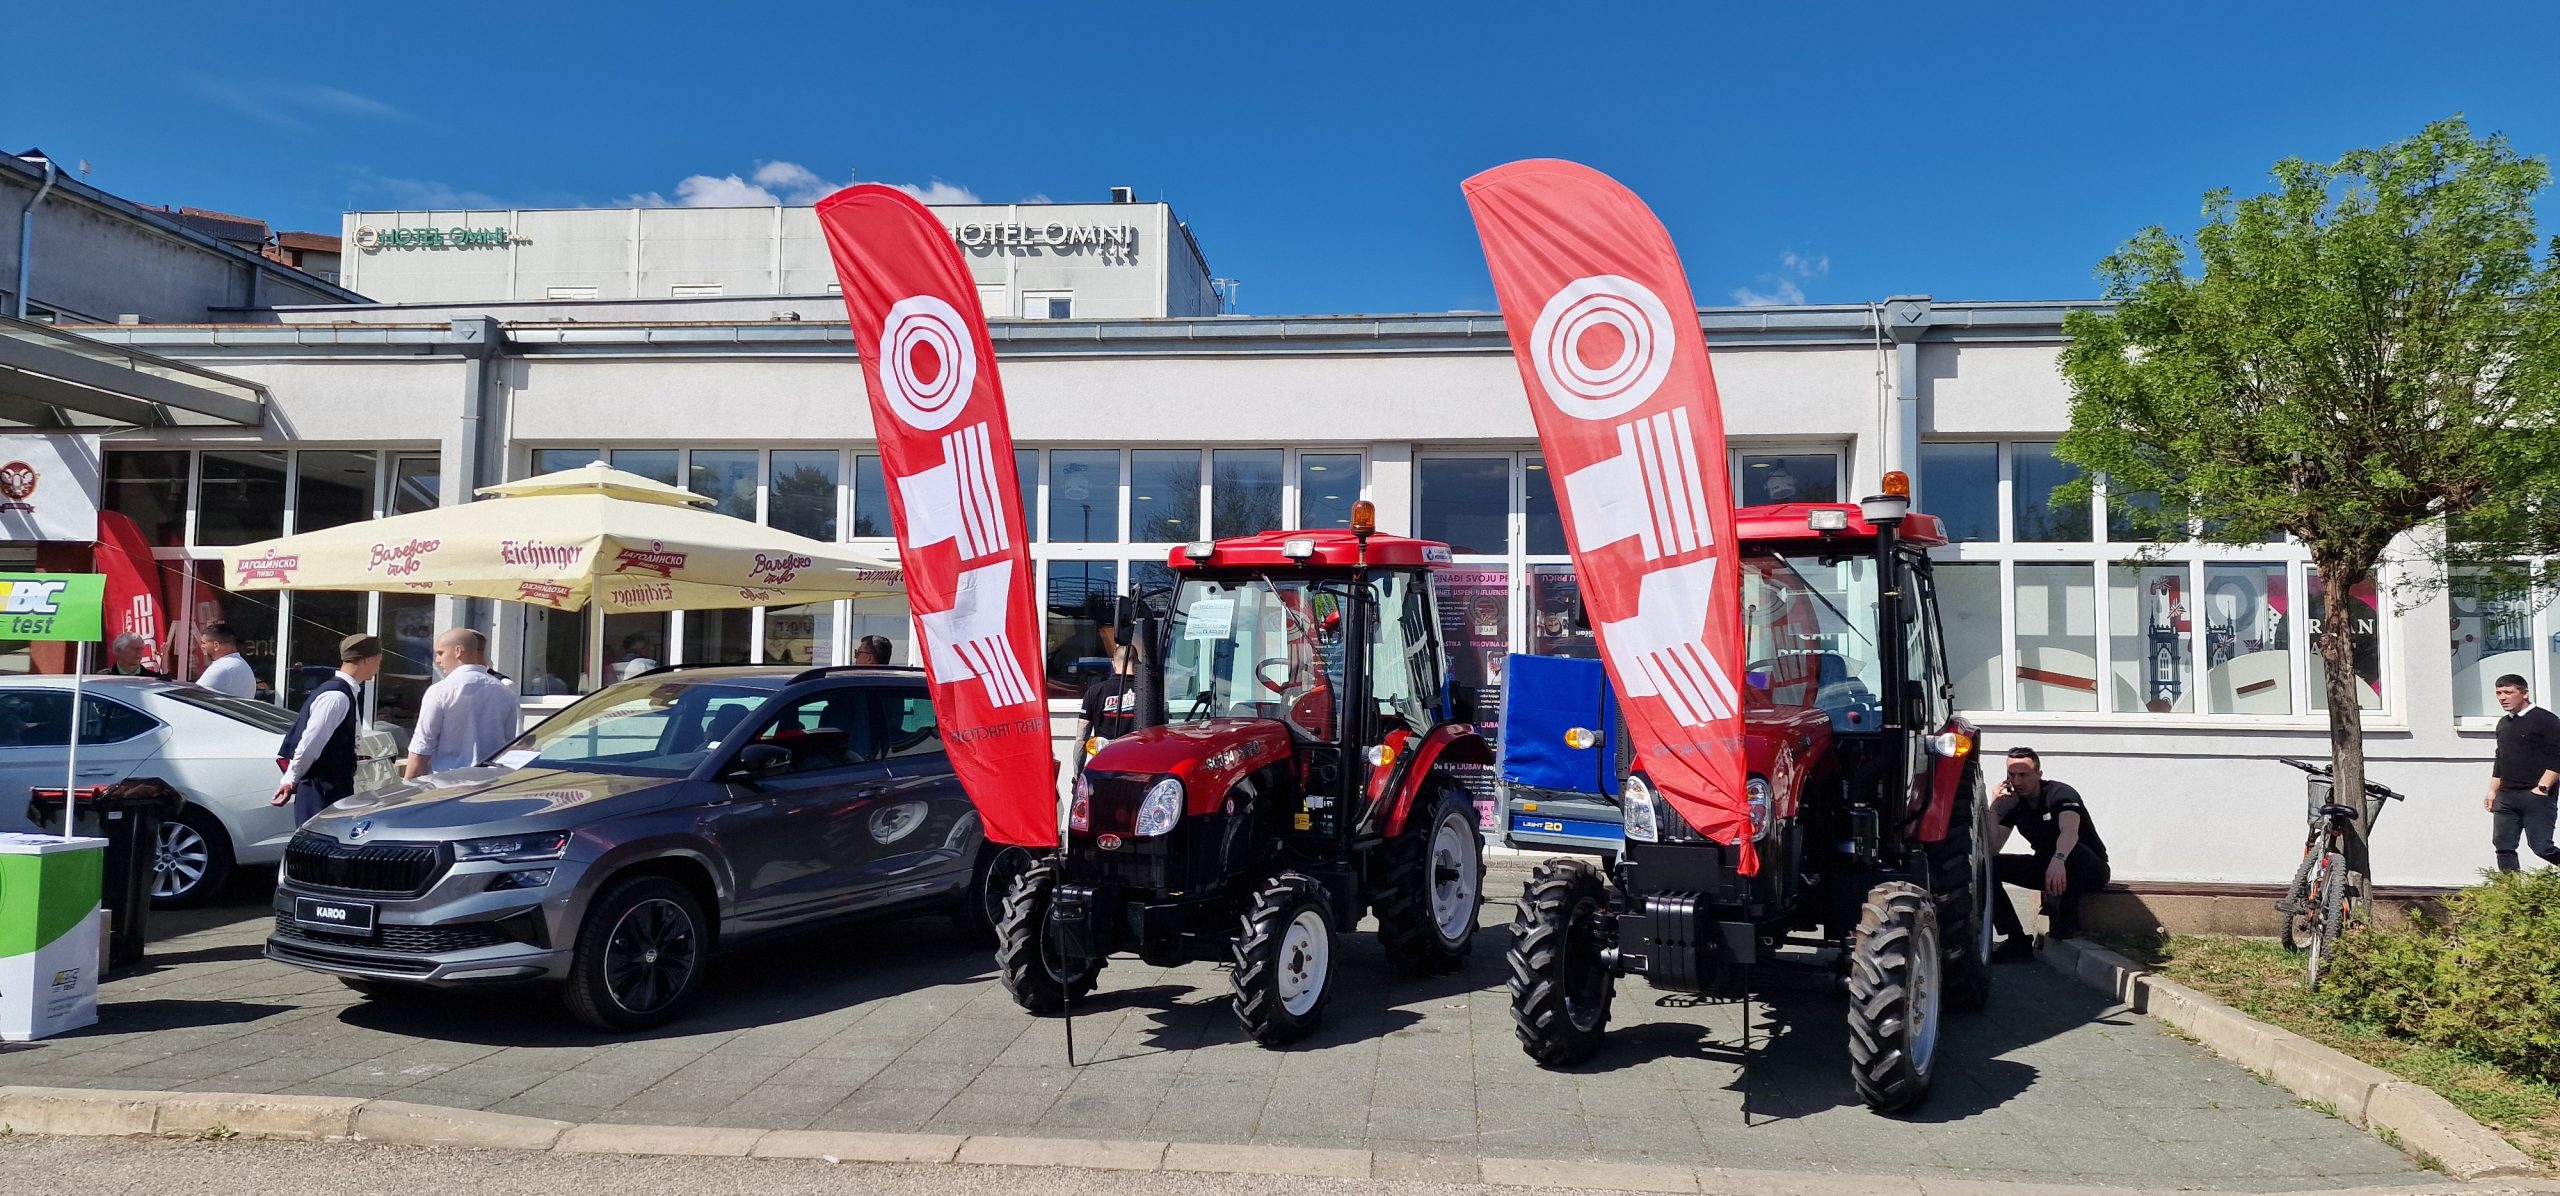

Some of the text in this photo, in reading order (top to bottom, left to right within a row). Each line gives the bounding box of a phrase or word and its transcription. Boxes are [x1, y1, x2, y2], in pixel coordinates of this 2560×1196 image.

[379, 226, 505, 245] HOTEL OMNI
[1043, 218, 1132, 246] OMNI
[501, 539, 584, 571] Eichinger
[1466, 574, 1497, 583] SVOJU
[0, 579, 69, 615] BC
[12, 616, 55, 634] test
[1544, 821, 1562, 831] 20
[316, 906, 346, 921] KAROQ
